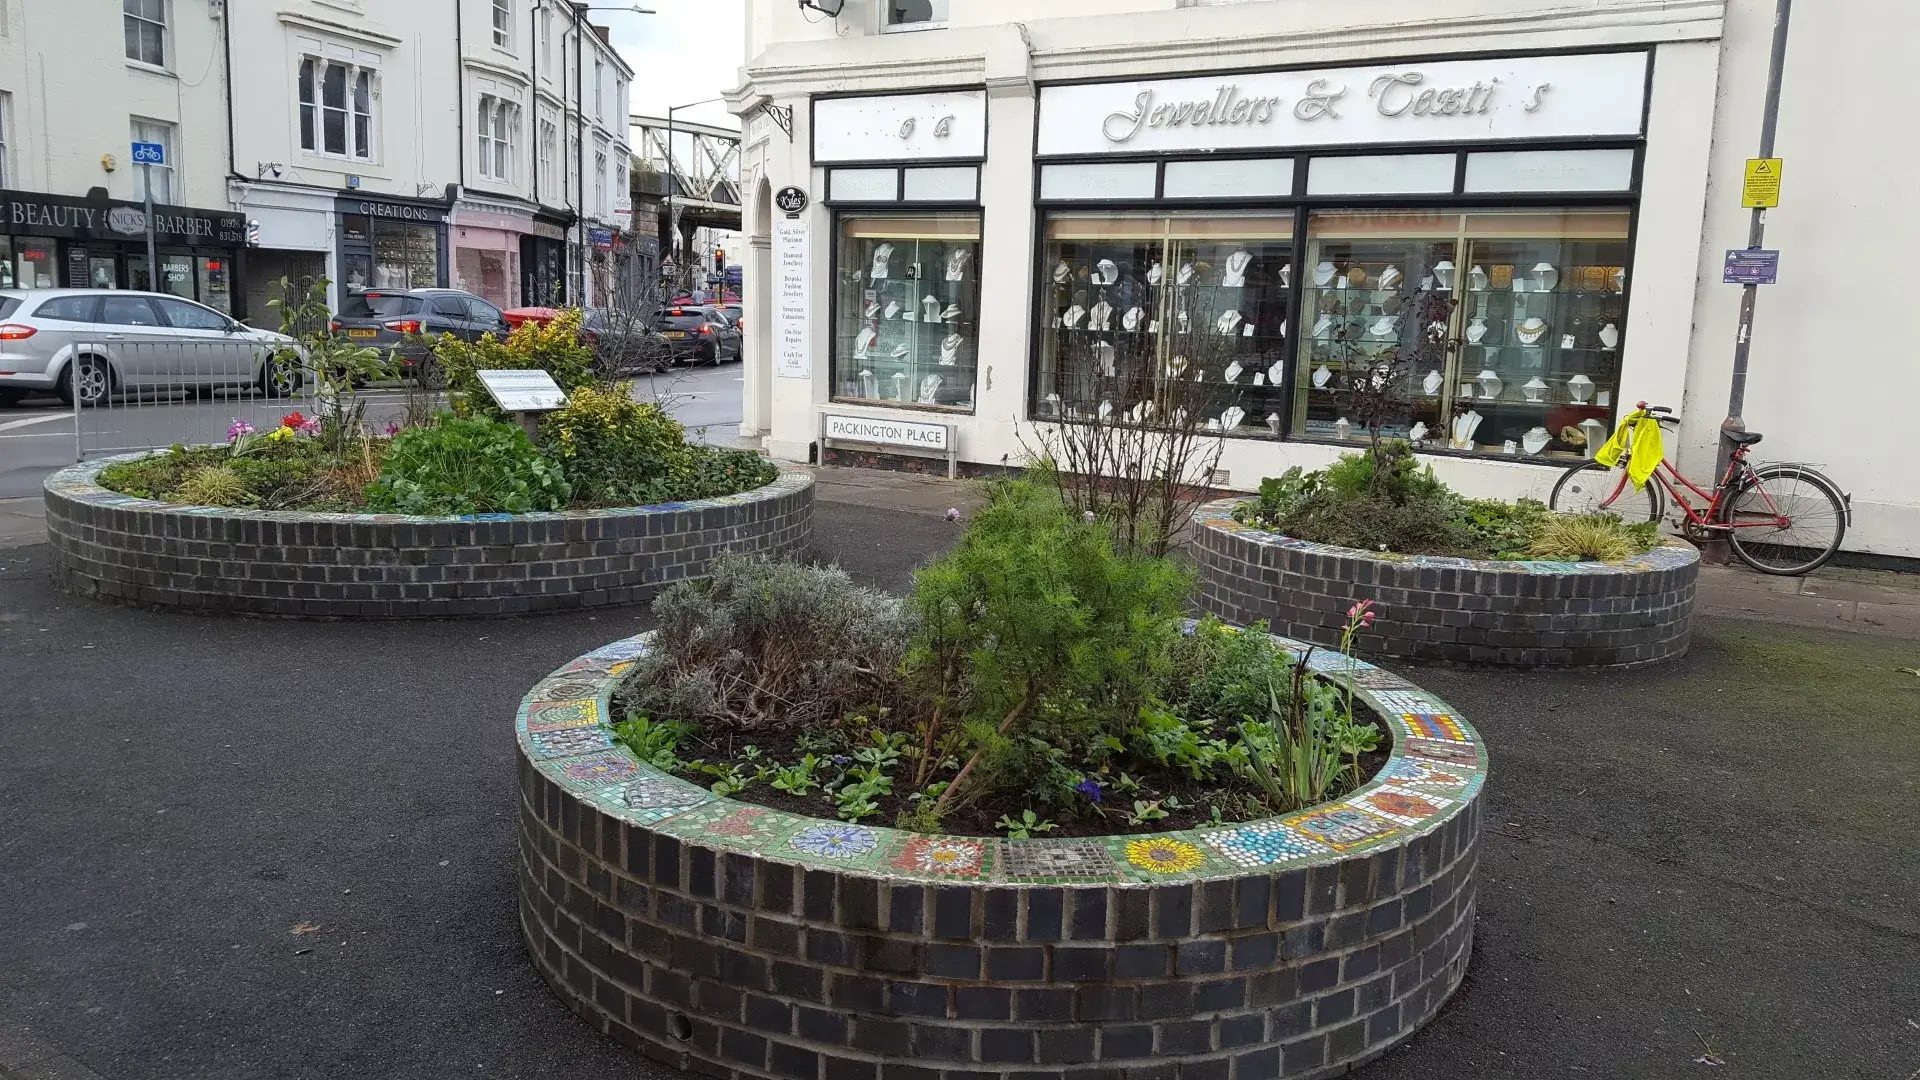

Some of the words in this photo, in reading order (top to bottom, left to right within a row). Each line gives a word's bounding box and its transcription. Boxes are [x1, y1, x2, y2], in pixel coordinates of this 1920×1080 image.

[1102, 84, 1279, 143] Jewellers
[1293, 79, 1348, 120] &
[11, 202, 95, 229] BEAUTY
[360, 202, 428, 219] CREATIONS
[155, 214, 213, 237] BARBER
[162, 263, 190, 272] BARBERS
[782, 260, 803, 268] Jewellery
[168, 273, 186, 282] SHOP
[784, 275, 802, 283] Bespoke
[833, 421, 902, 439] PACKINGTON
[907, 429, 941, 443] PLACE
